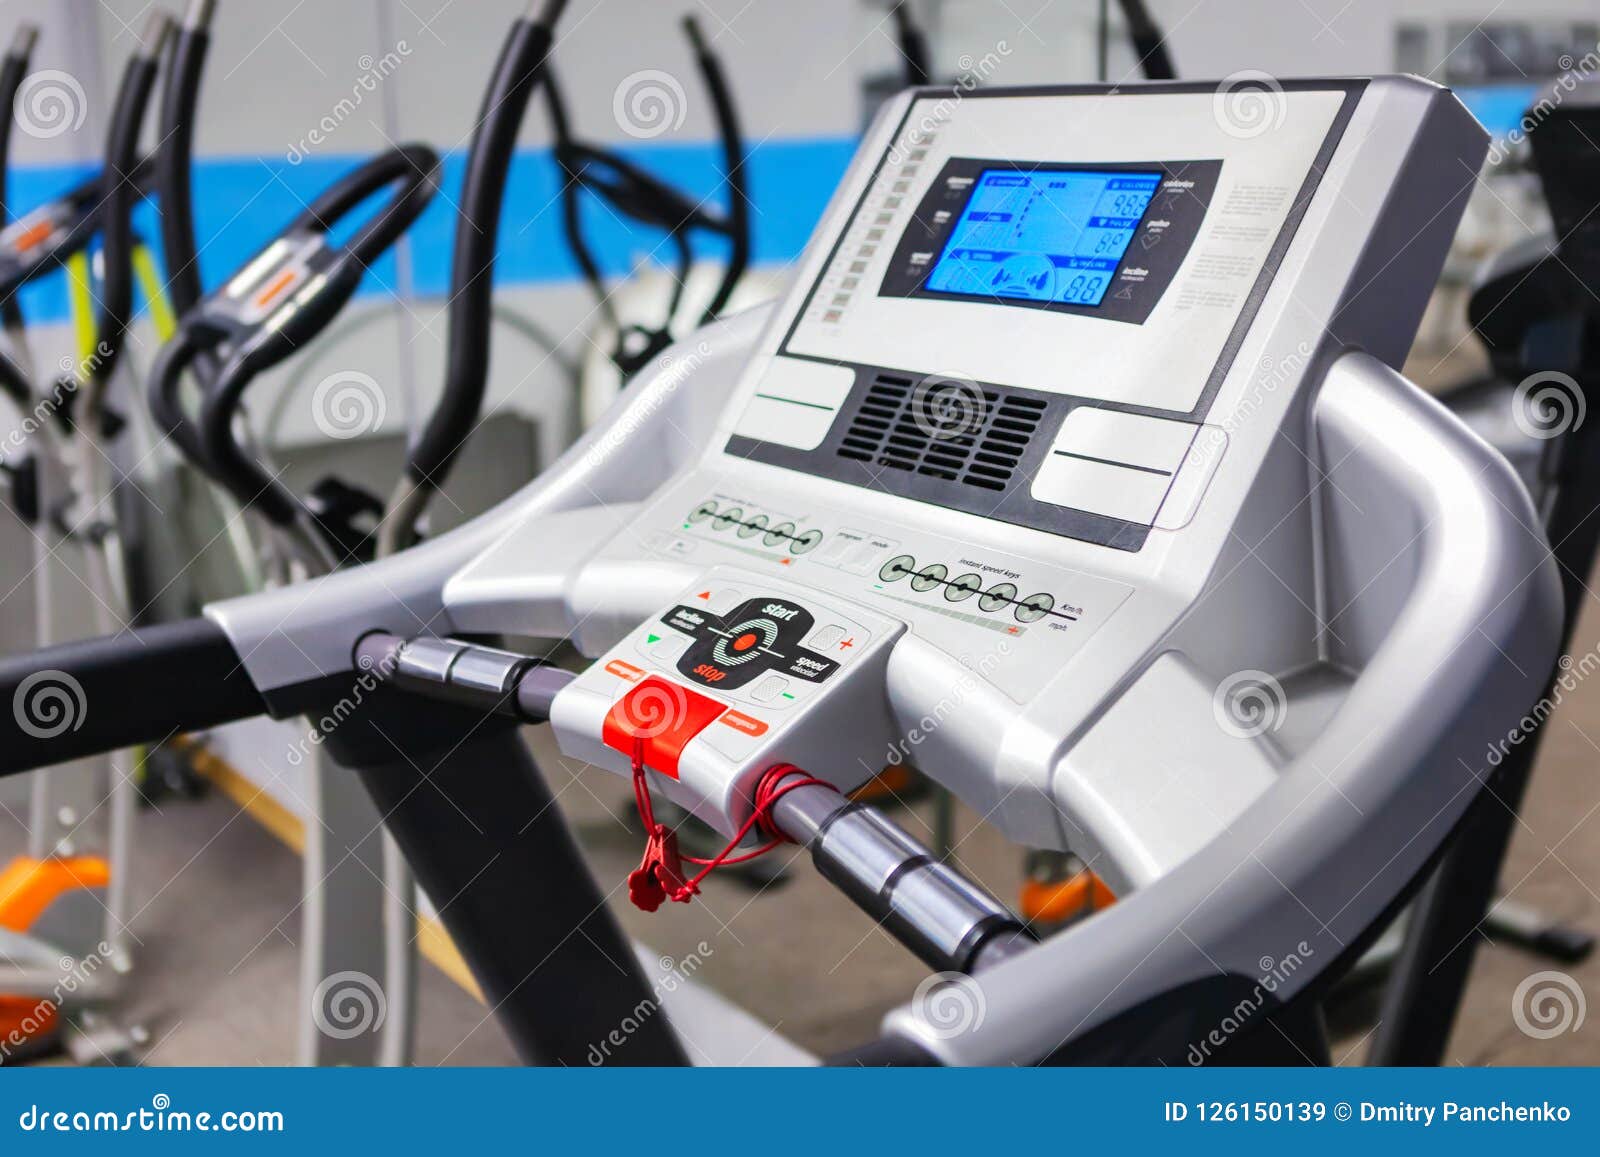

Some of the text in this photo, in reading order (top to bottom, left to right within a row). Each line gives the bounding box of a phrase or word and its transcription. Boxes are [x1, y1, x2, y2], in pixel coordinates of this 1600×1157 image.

[1004, 569, 1021, 580] keys
[761, 603, 799, 621] start
[795, 657, 830, 671] speed
[692, 663, 727, 683] stop
